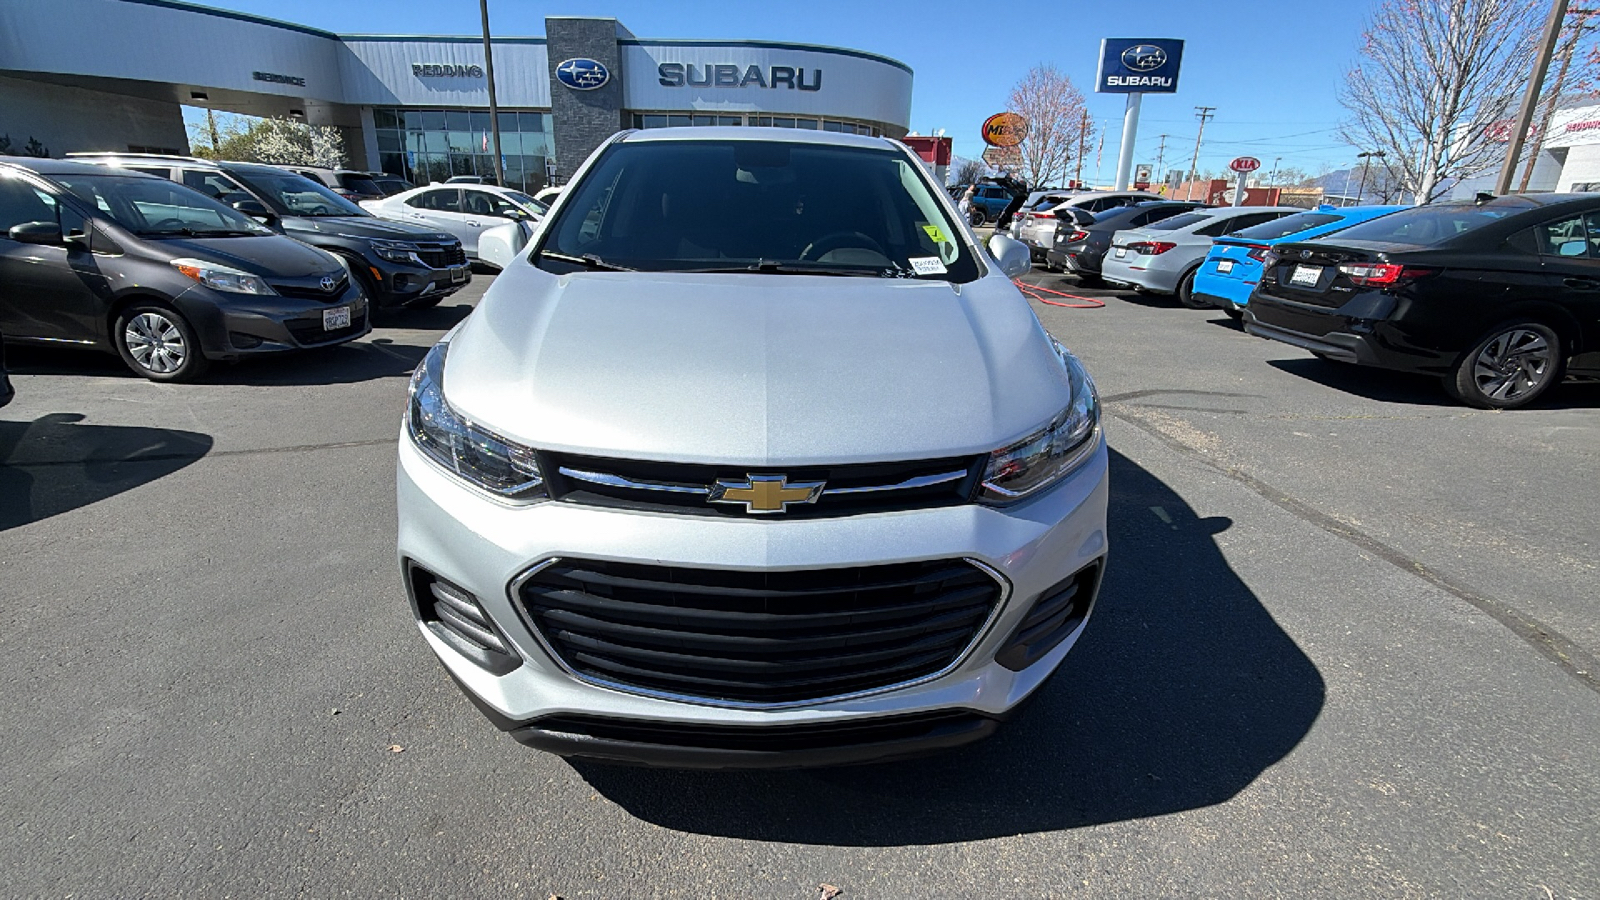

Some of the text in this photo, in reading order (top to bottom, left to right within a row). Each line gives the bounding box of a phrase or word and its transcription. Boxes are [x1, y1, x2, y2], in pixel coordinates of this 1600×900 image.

[412, 63, 483, 78] REDDING
[658, 63, 822, 92] SUBARU
[1107, 76, 1173, 87] SUBARU
[1235, 159, 1257, 169] KIA
